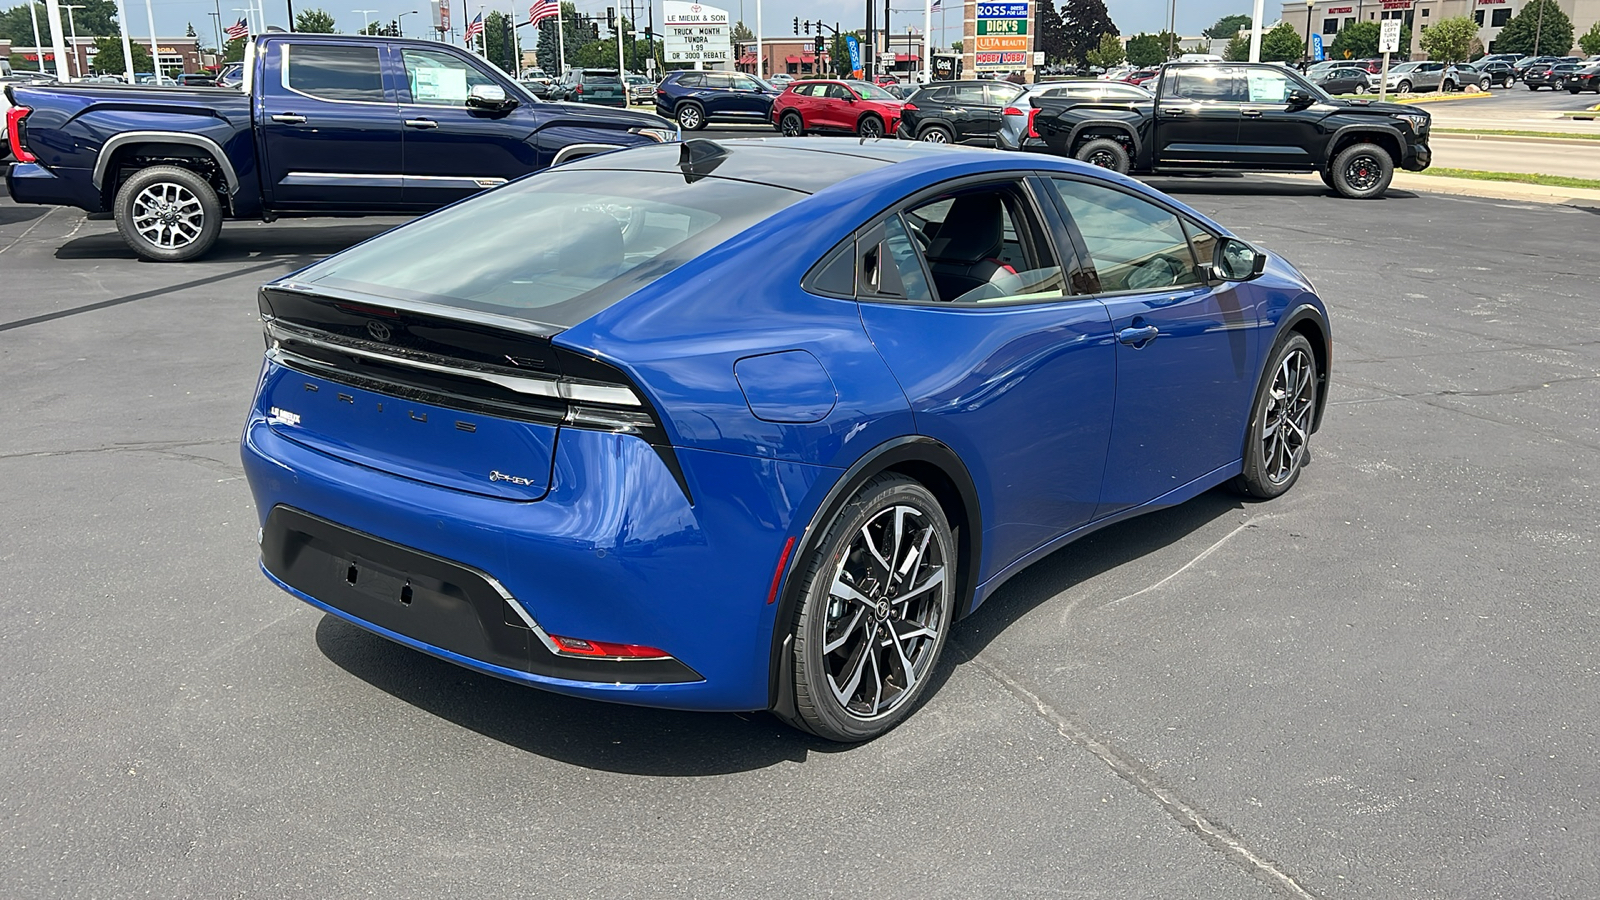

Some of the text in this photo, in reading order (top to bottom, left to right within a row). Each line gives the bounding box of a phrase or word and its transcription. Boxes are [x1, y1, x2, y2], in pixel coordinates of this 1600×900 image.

[978, 6, 1007, 16] ROSS
[987, 20, 1018, 31] DICK'S
[979, 38, 1000, 47] ULTA
[849, 41, 859, 62] ROSS
[976, 53, 1001, 64] HOBBY
[1002, 53, 1025, 63] LOBBY
[937, 59, 951, 70] Geek
[504, 354, 545, 369] XSE
[271, 406, 280, 417] LE
[304, 383, 477, 433] PRIUS
